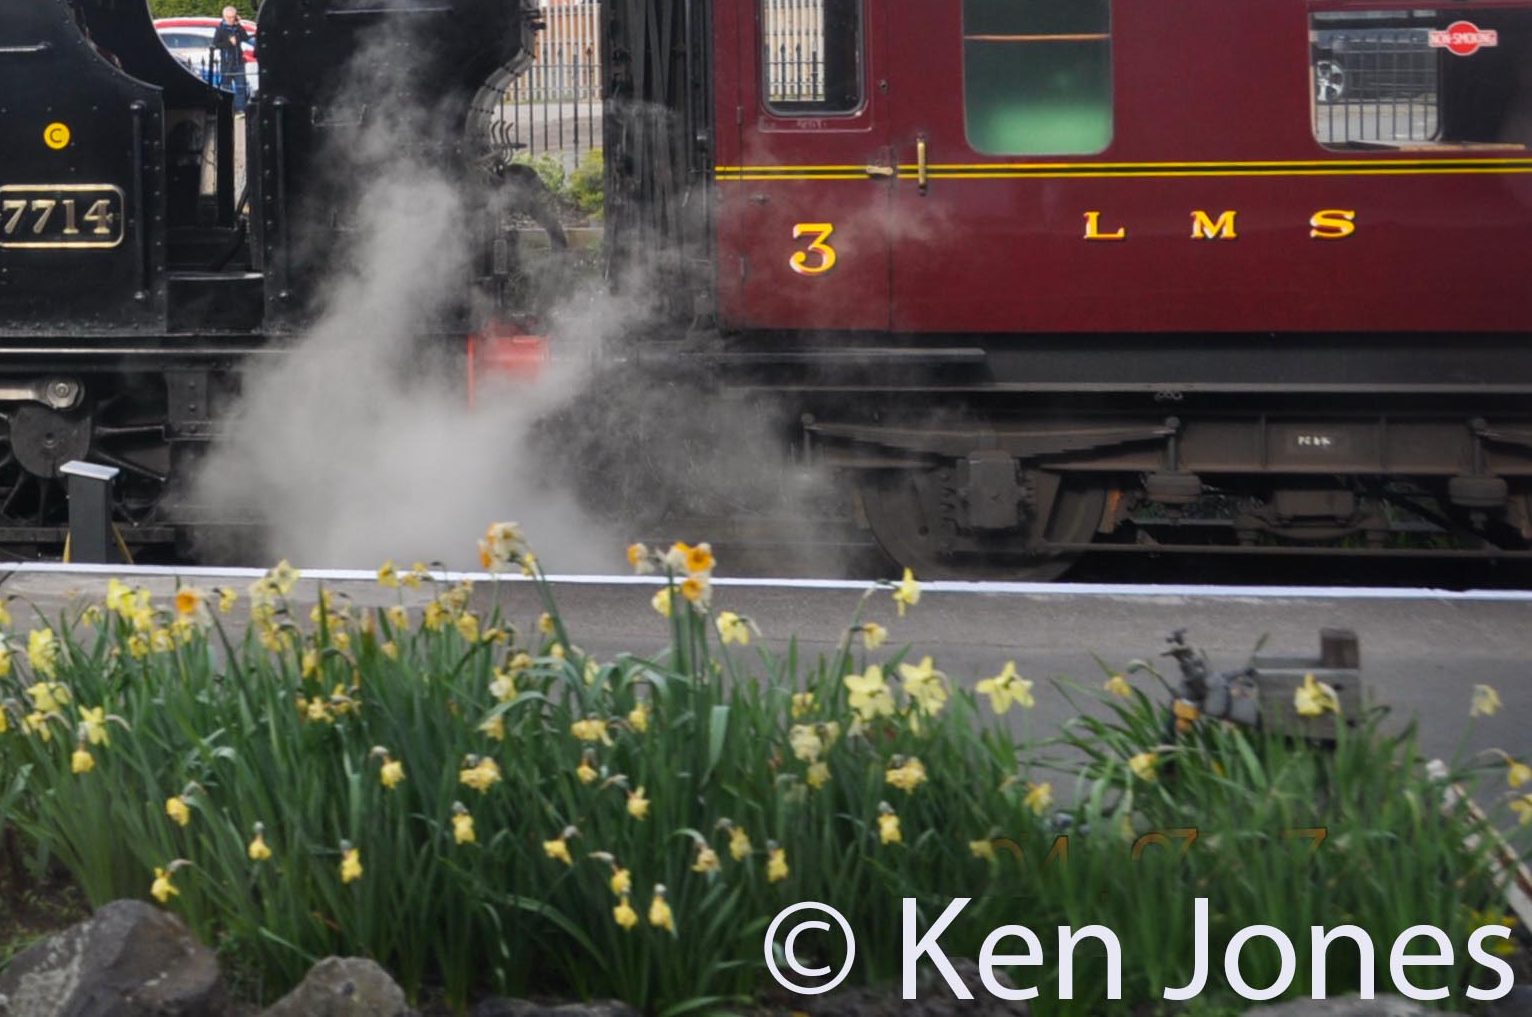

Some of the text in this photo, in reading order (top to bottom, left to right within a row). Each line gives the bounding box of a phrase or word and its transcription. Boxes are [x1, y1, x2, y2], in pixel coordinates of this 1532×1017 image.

[49, 127, 63, 143] C
[3, 199, 111, 234] 7714
[790, 223, 837, 275] 3
